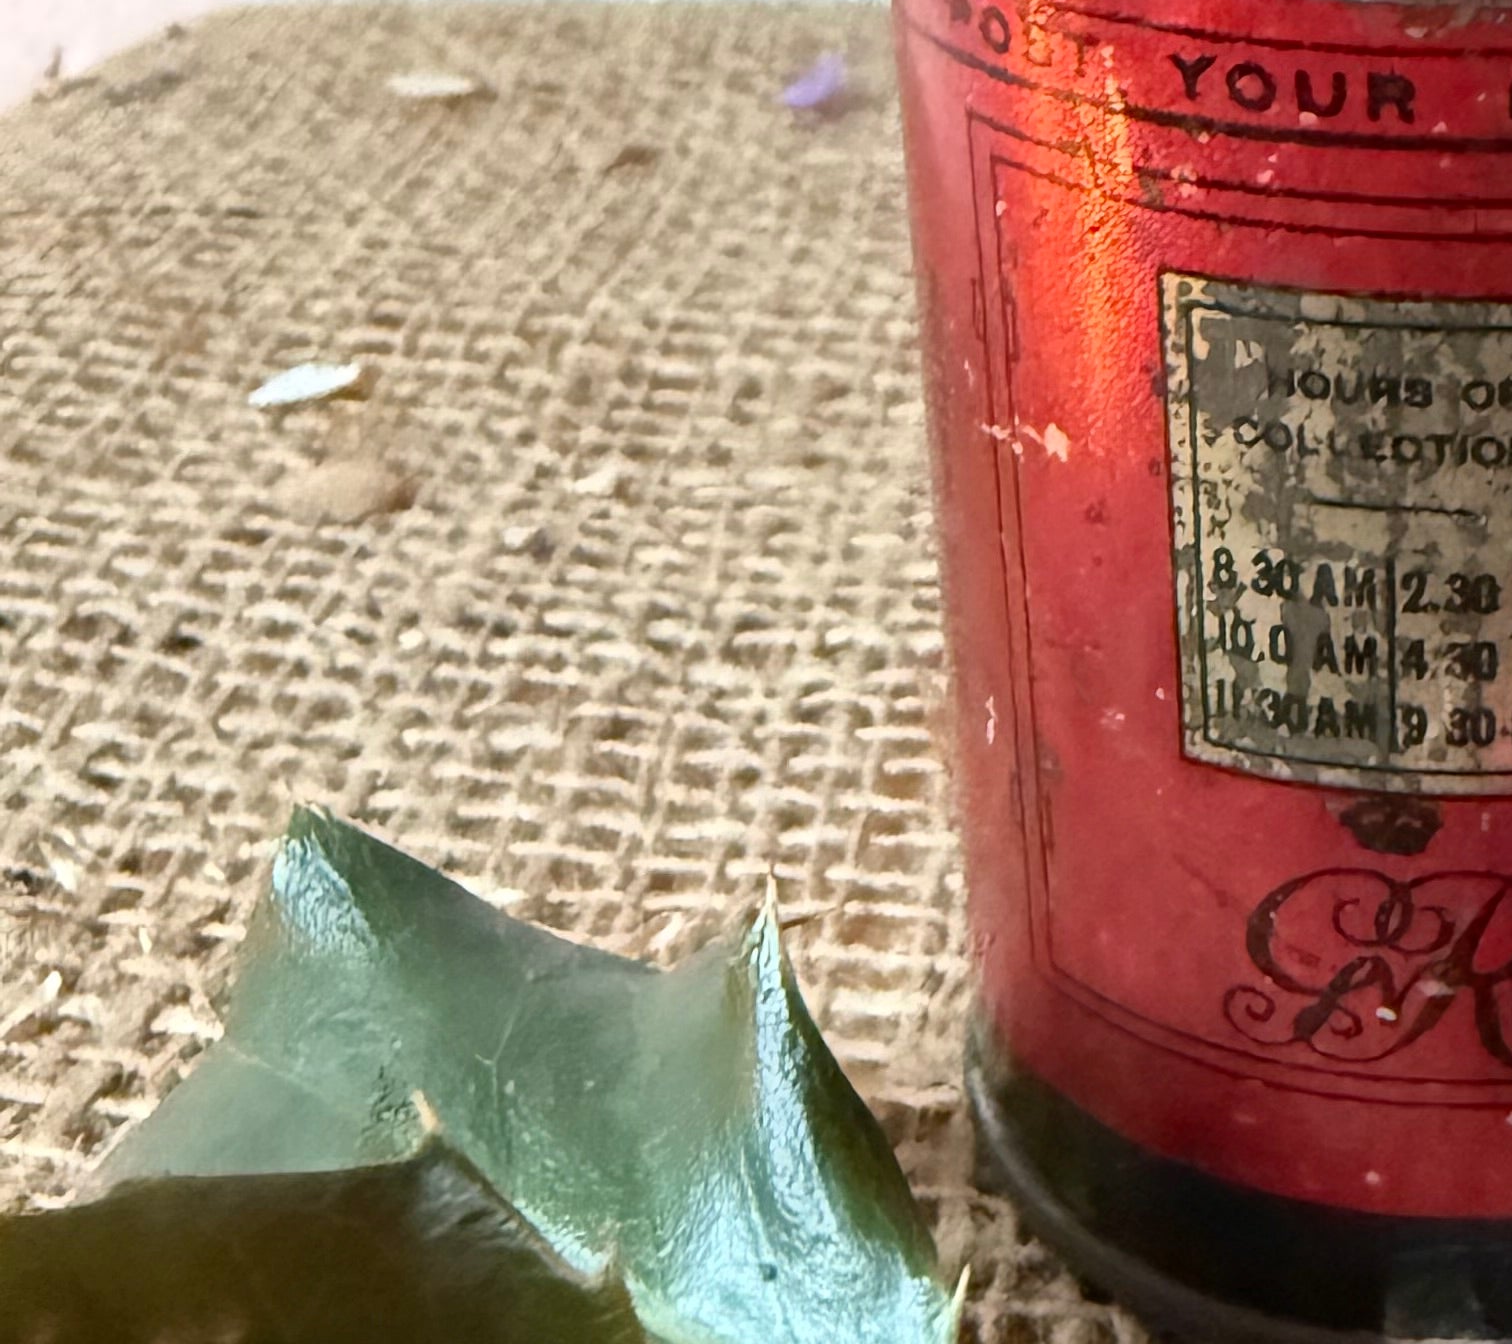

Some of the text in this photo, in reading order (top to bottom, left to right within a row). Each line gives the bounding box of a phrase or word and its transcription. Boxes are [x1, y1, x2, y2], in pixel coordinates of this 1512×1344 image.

[1169, 53, 1416, 125] YOUR
[1267, 369, 1434, 409] HOURS
[1310, 562, 1378, 608] AM
[1401, 570, 1502, 615] 2.30
[1312, 631, 1379, 677] AM
[1216, 678, 1309, 734] 1130
[1402, 704, 1497, 748] 930
